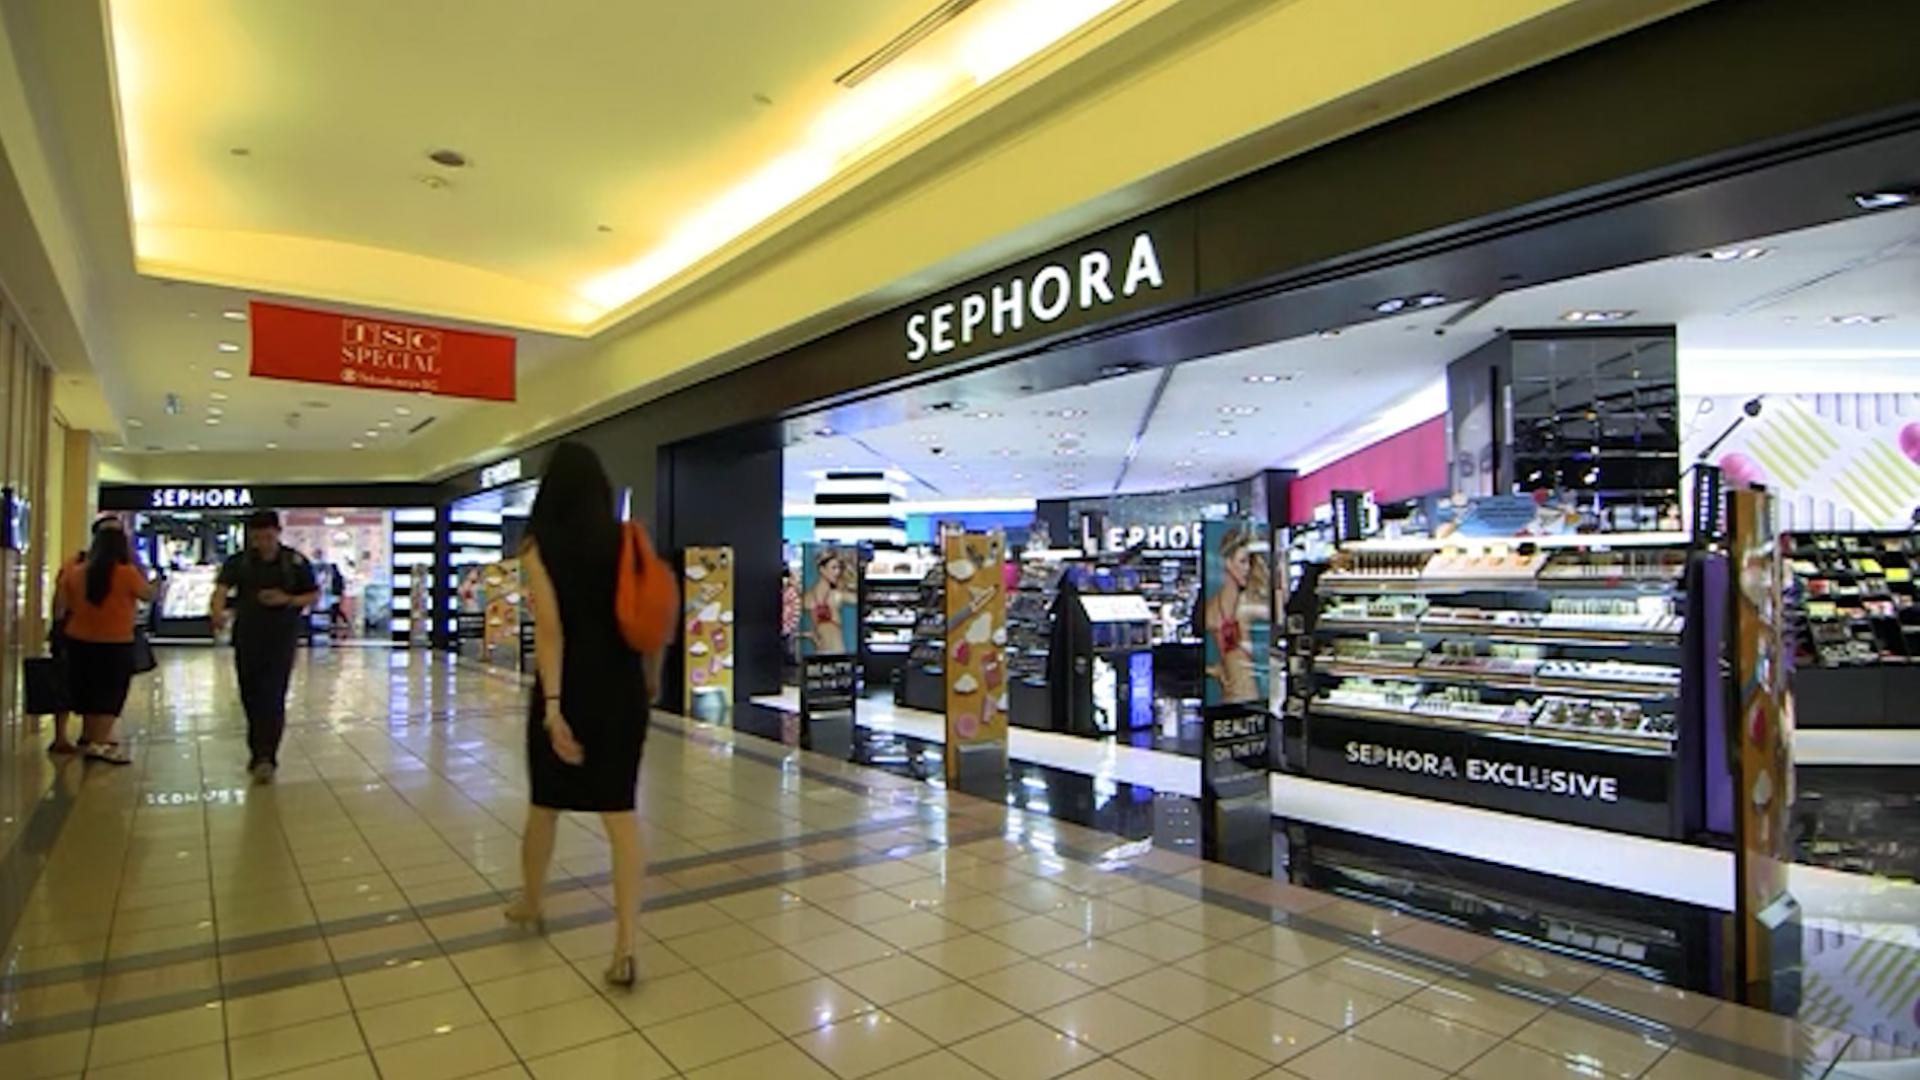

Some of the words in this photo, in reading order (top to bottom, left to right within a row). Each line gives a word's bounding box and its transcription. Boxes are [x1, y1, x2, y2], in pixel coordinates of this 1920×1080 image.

[906, 233, 1163, 361] SEPHORA
[342, 347, 441, 374] SPECIAL
[152, 488, 252, 507] SEPHORA
[1107, 522, 1202, 552] EPHOR
[1213, 714, 1265, 739] BEAUTY
[1346, 741, 1457, 778] SEPHORA
[1465, 758, 1618, 802] EXCLUSIVE
